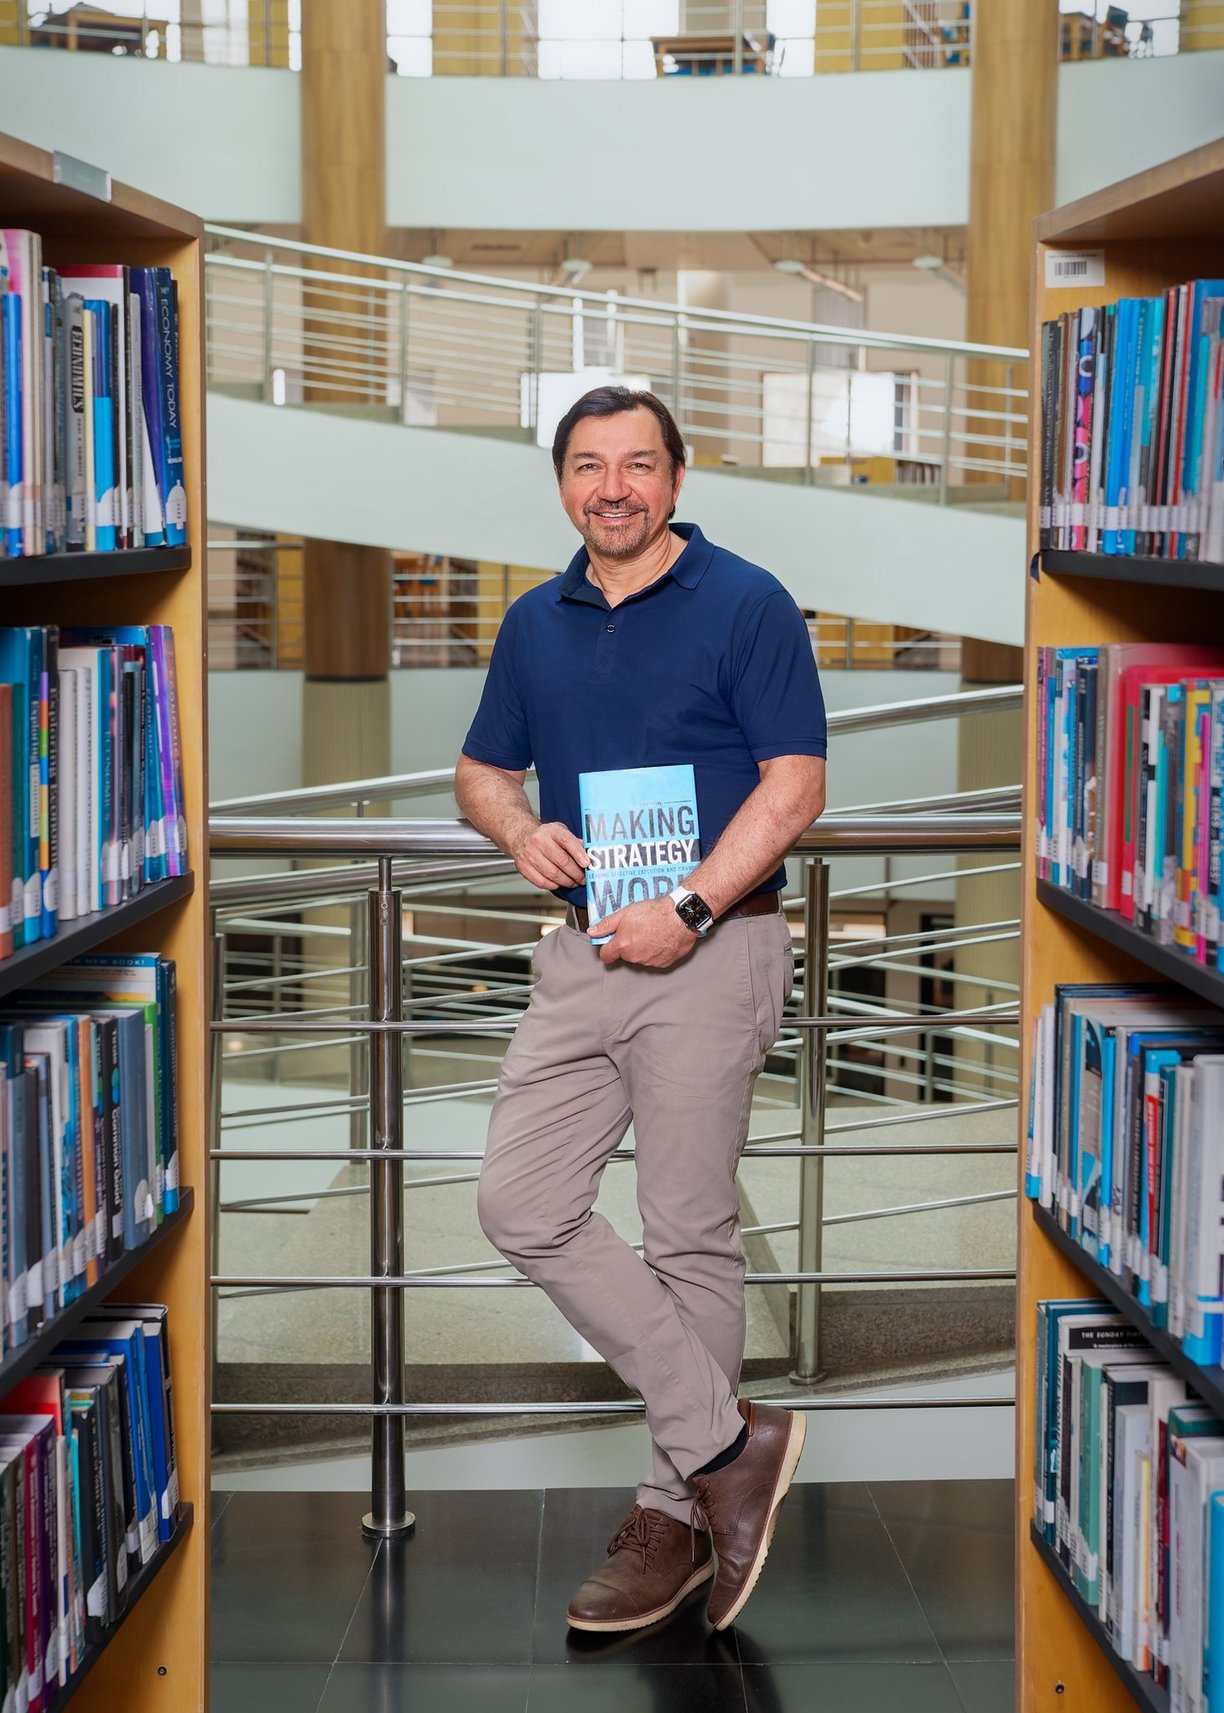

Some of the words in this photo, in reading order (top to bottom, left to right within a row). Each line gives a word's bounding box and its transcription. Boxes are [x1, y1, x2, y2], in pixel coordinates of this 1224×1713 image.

[161, 298, 174, 378] ECONOMY
[71, 326, 86, 412] ECONOMICS
[166, 384, 178, 428] TODAY
[31, 699, 41, 764] Exploring
[48, 687, 58, 778] Exploring
[169, 669, 181, 769] ECONOMICS
[104, 730, 112, 821] ECONOMICS
[585, 805, 695, 844] MAKING
[587, 838, 695, 872] STRATEGY
[611, 868, 637, 878] EFFECTIVE
[637, 866, 665, 877] EXECUTION
[666, 865, 678, 874] AND
[679, 863, 696, 873] CHANG
[590, 874, 684, 917] WOR
[111, 1107, 120, 1168] Common
[113, 1168, 123, 1206] Good
[1081, 1331, 1094, 1339] THE
[1096, 1330, 1124, 1339] SUNDAY
